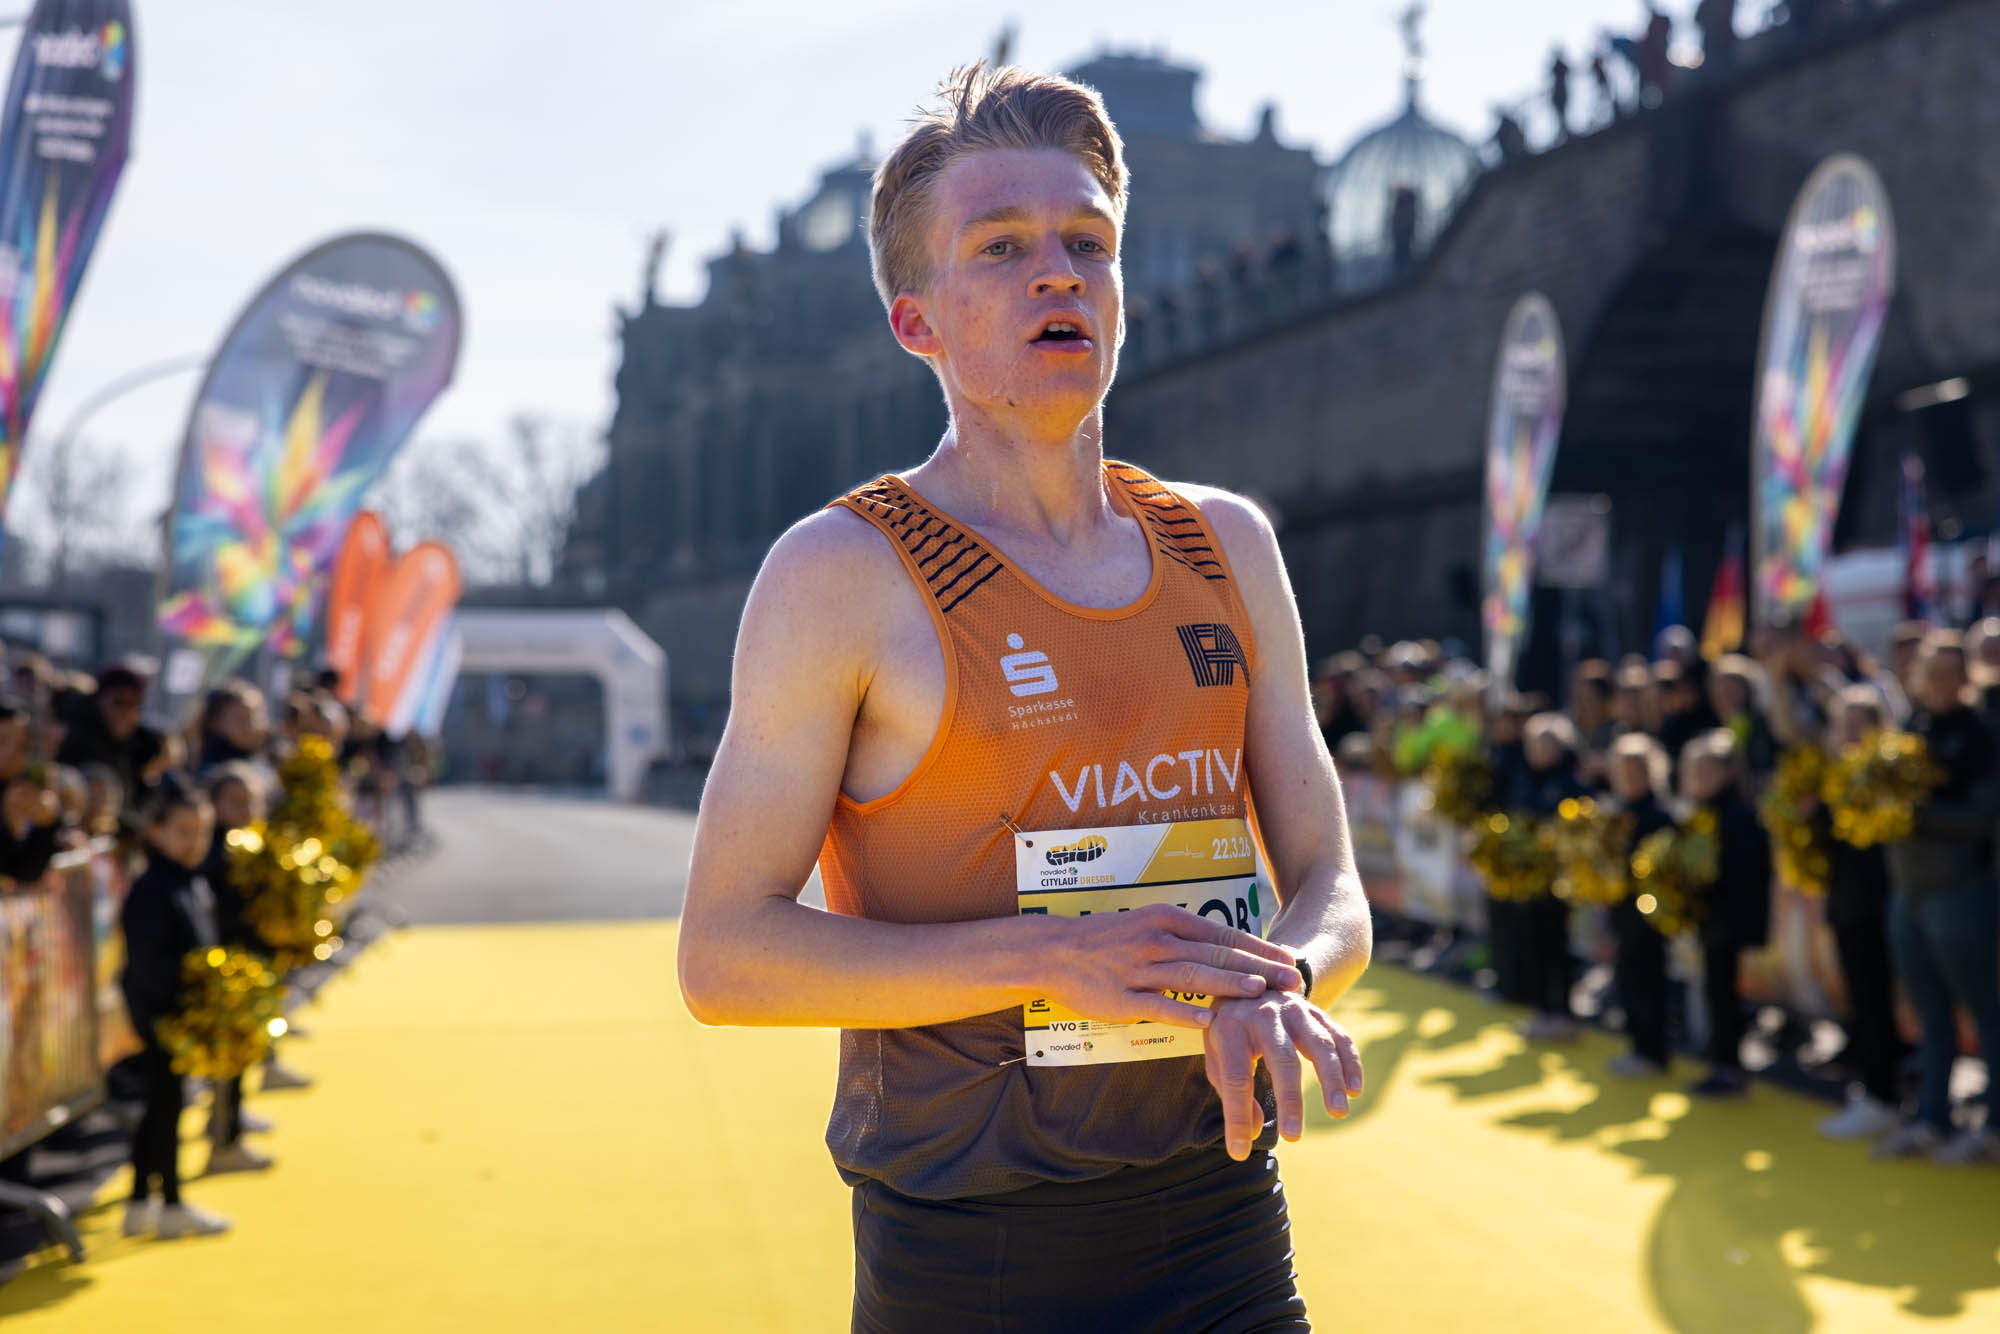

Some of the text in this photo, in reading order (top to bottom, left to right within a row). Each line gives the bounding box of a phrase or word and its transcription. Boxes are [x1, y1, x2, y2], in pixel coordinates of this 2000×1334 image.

[1008, 698, 1074, 719] Sparkasse
[1050, 748, 1240, 812] VIACTIV
[1212, 837, 1251, 860] 22.3.26
[1040, 868, 1067, 876] novaled
[1041, 874, 1116, 887] CITYLAUF DRESDEN
[1051, 1022, 1077, 1032] VVO
[1050, 1043, 1081, 1052] novaled
[1130, 1037, 1168, 1047] SAXOPRINT
